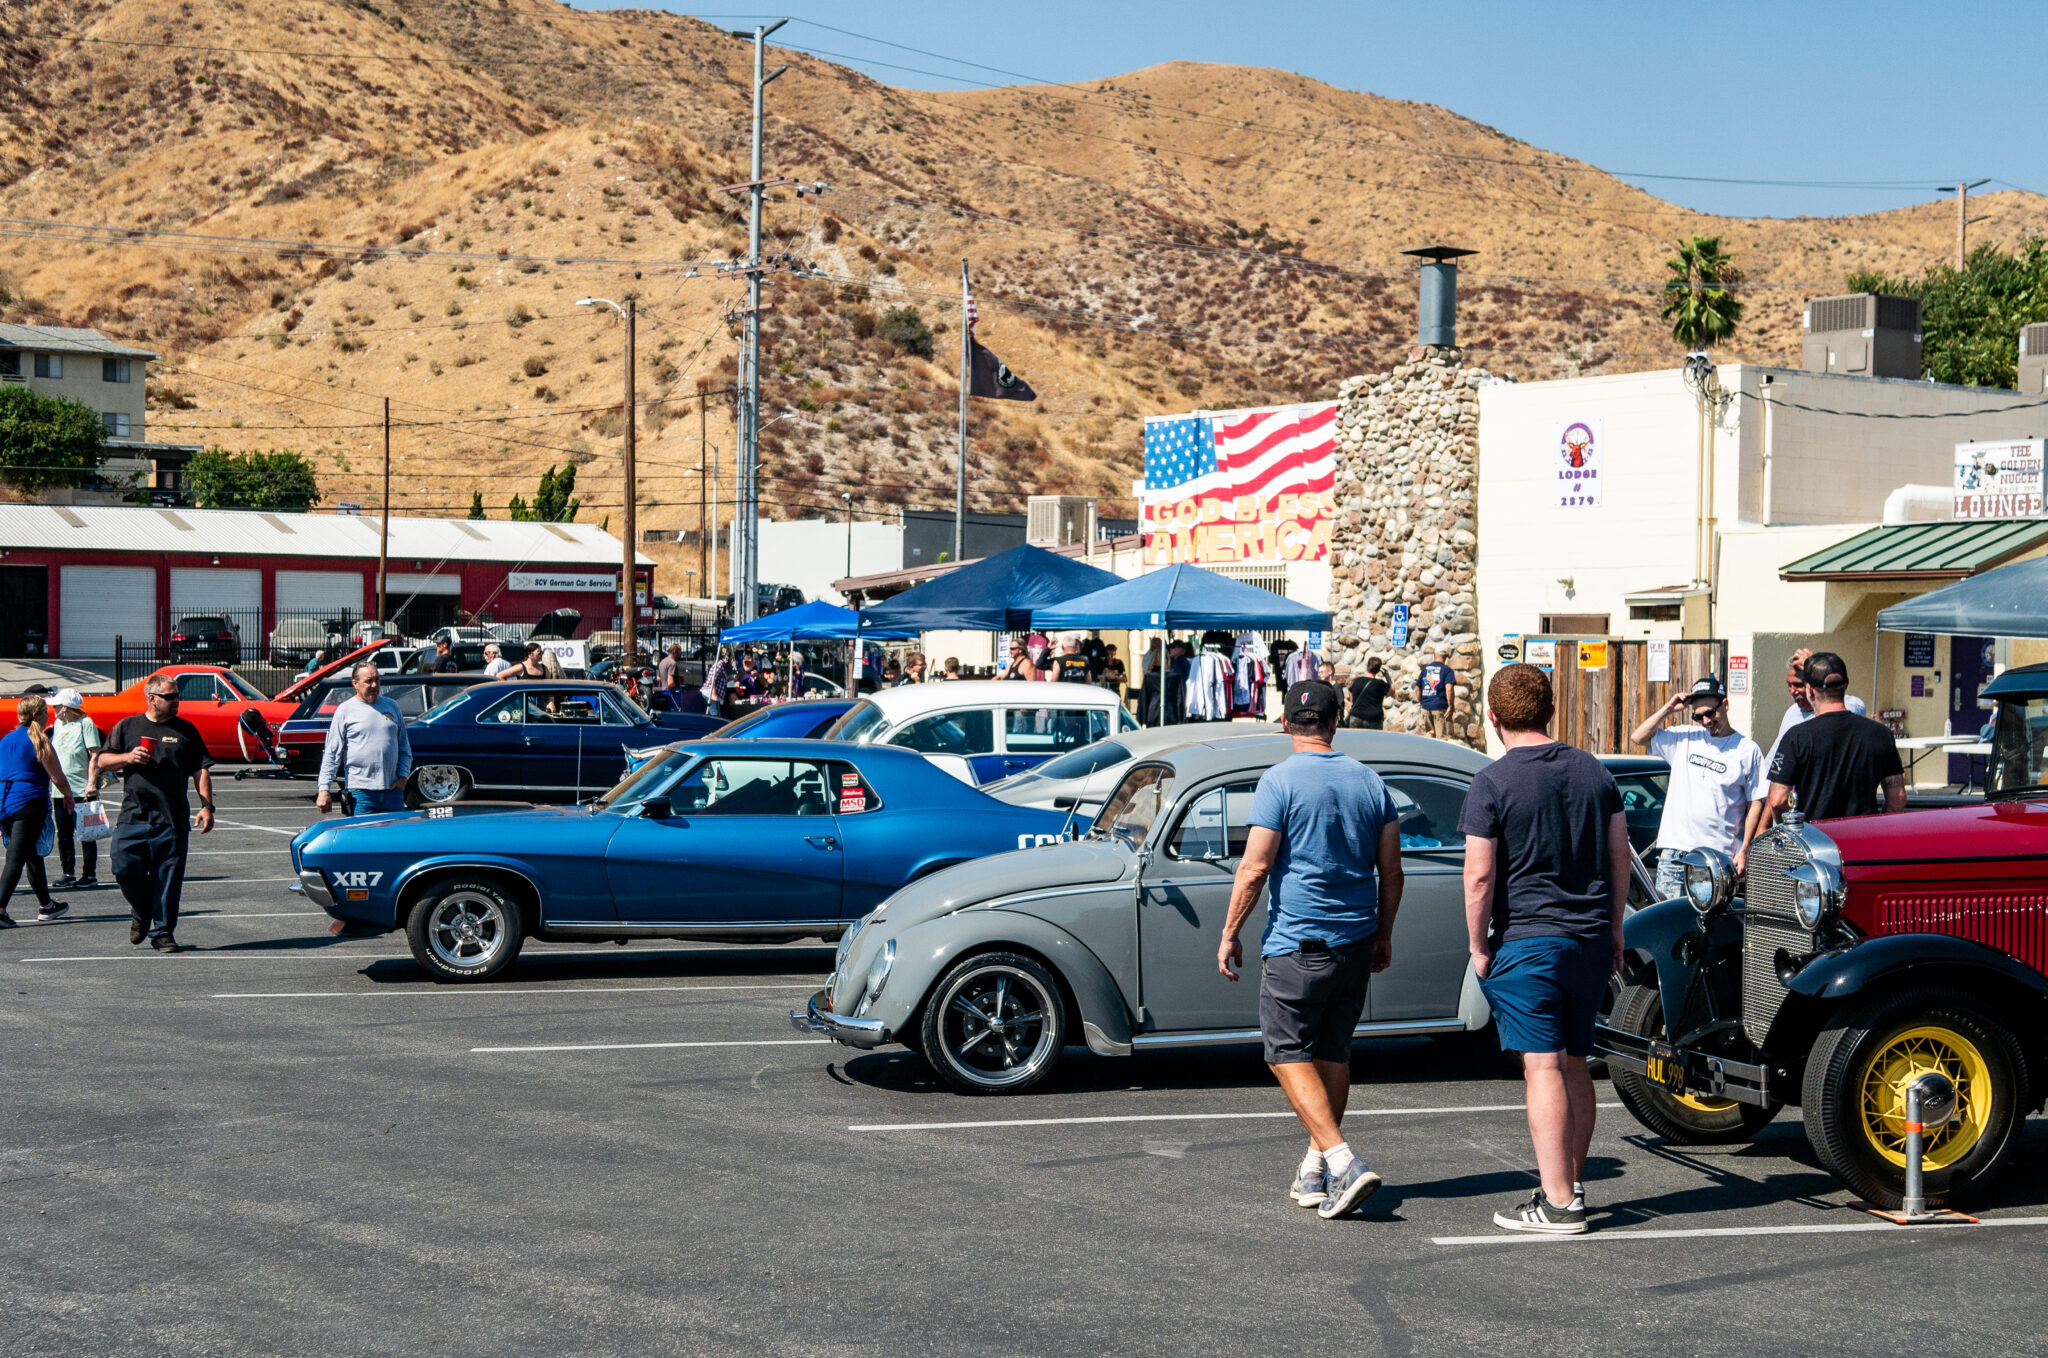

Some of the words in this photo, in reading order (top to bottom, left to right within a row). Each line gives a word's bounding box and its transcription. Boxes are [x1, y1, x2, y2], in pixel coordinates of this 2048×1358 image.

[2010, 445, 2032, 457] THE
[2000, 459, 2041, 471] GOLDEN
[1559, 469, 1597, 480] LODGE
[2000, 472, 2040, 485] NUGGET
[1152, 497, 1223, 526] GOD
[1235, 491, 1338, 523] BLESS
[1955, 493, 2042, 518] LOUNGE
[1145, 519, 1335, 565] AMERICA
[549, 579, 575, 587] German
[576, 579, 587, 587] Car
[588, 579, 613, 588] Service
[1883, 711, 1903, 719] GOD
[841, 798, 865, 808] MSD
[428, 806, 453, 815] 302
[332, 871, 384, 887] XR7
[453, 883, 491, 893] Radial
[1647, 1055, 1666, 1084] HUL
[1667, 1062, 1685, 1089] 998
